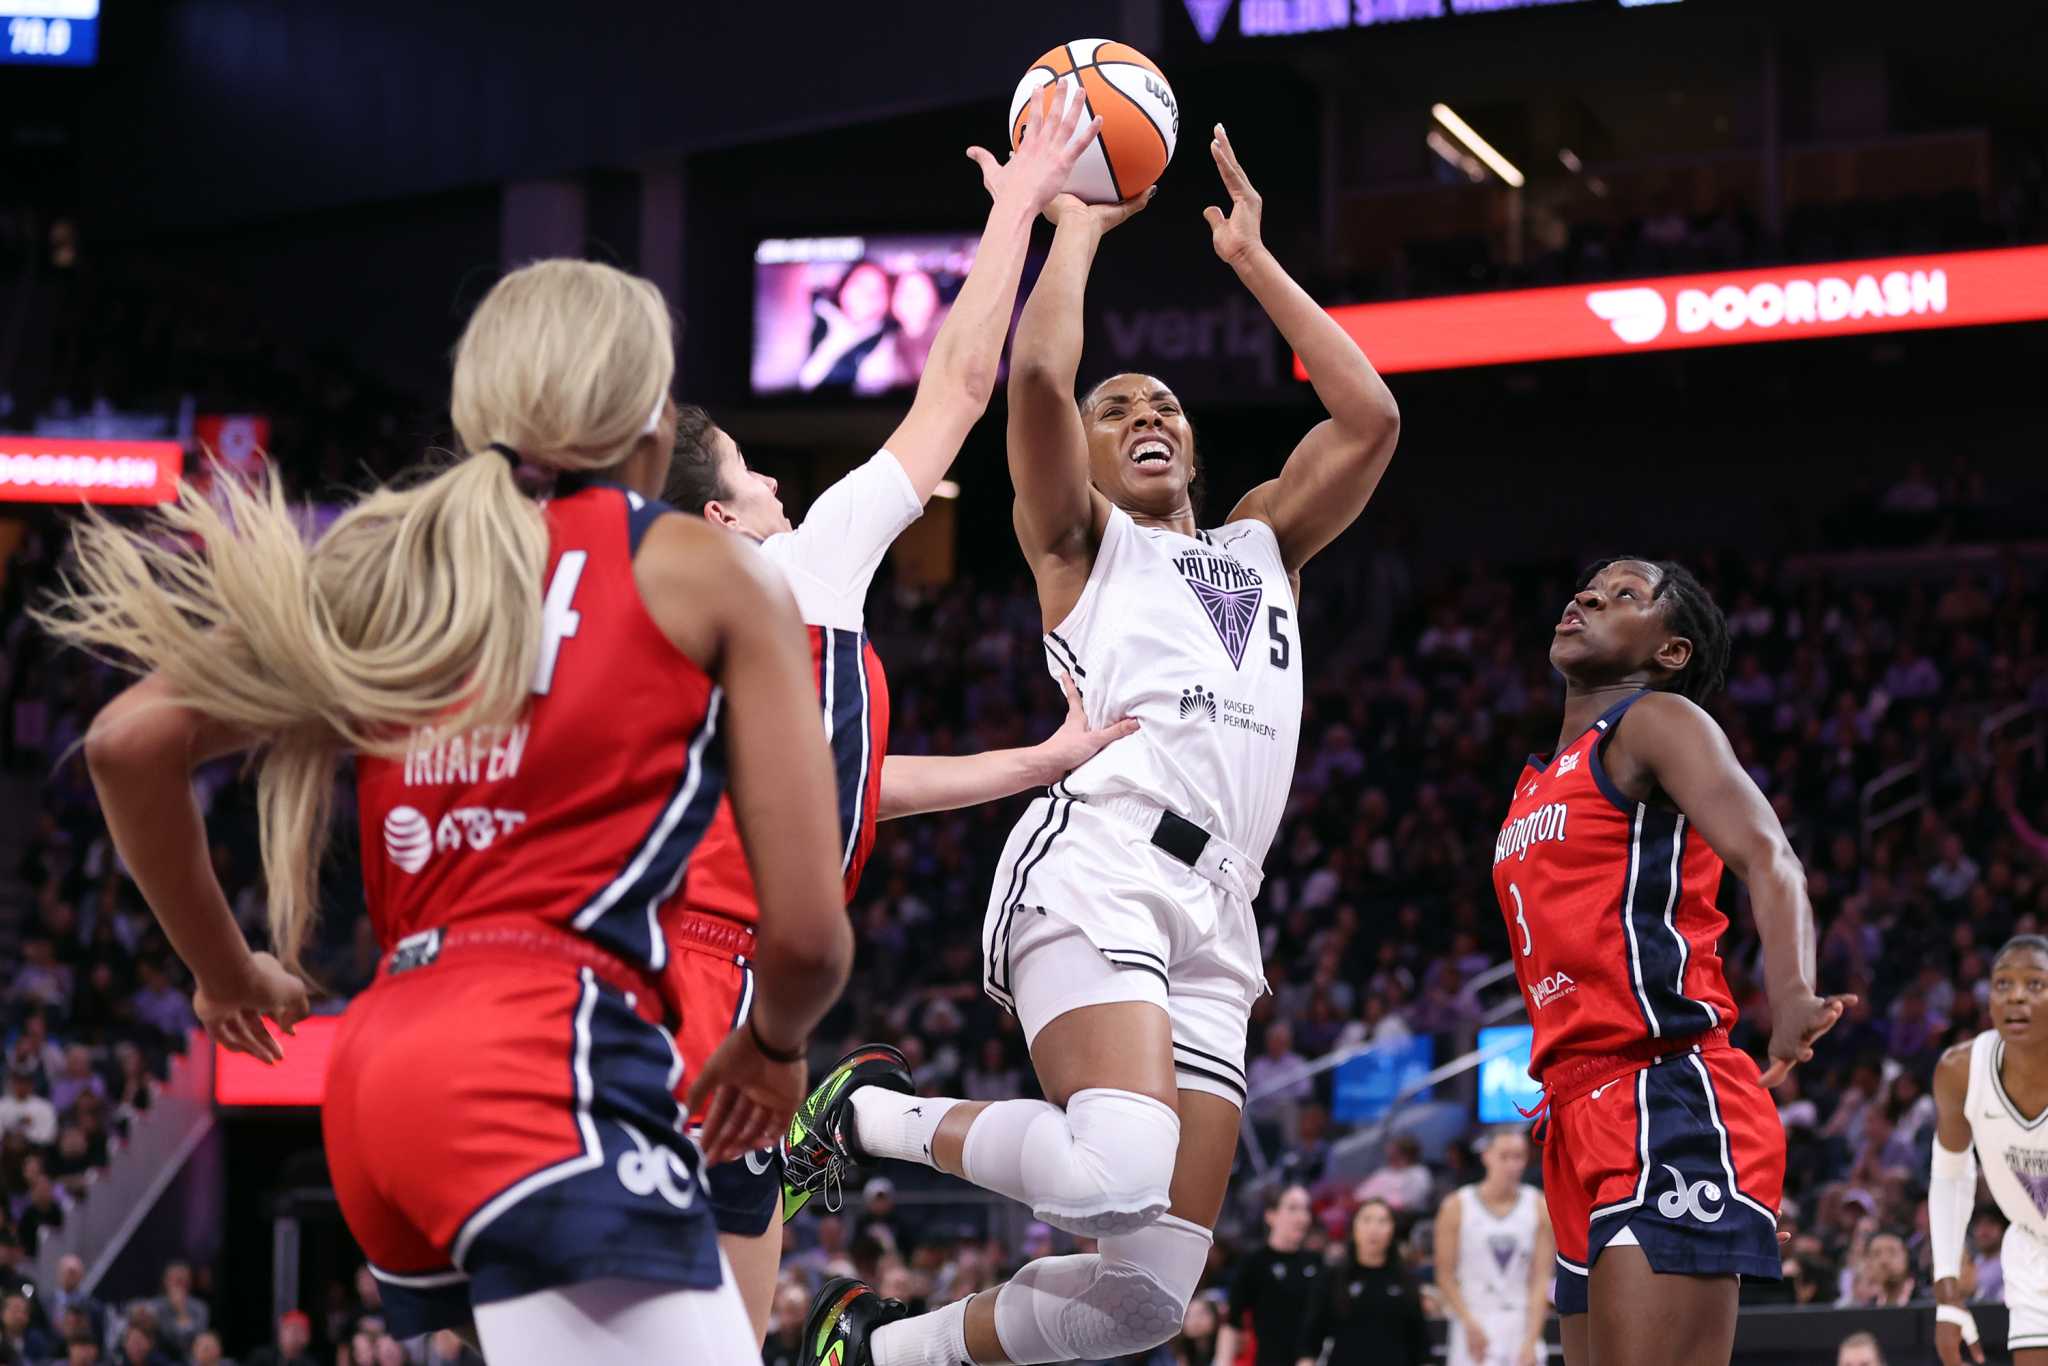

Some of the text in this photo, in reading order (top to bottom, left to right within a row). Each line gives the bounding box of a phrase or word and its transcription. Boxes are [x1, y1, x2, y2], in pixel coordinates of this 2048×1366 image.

[1675, 267, 1948, 335] DOORDASH
[1267, 604, 1290, 671] 5
[1223, 699, 1255, 716] KAISER
[435, 806, 527, 856] AT&T
[1509, 882, 1532, 957] 3
